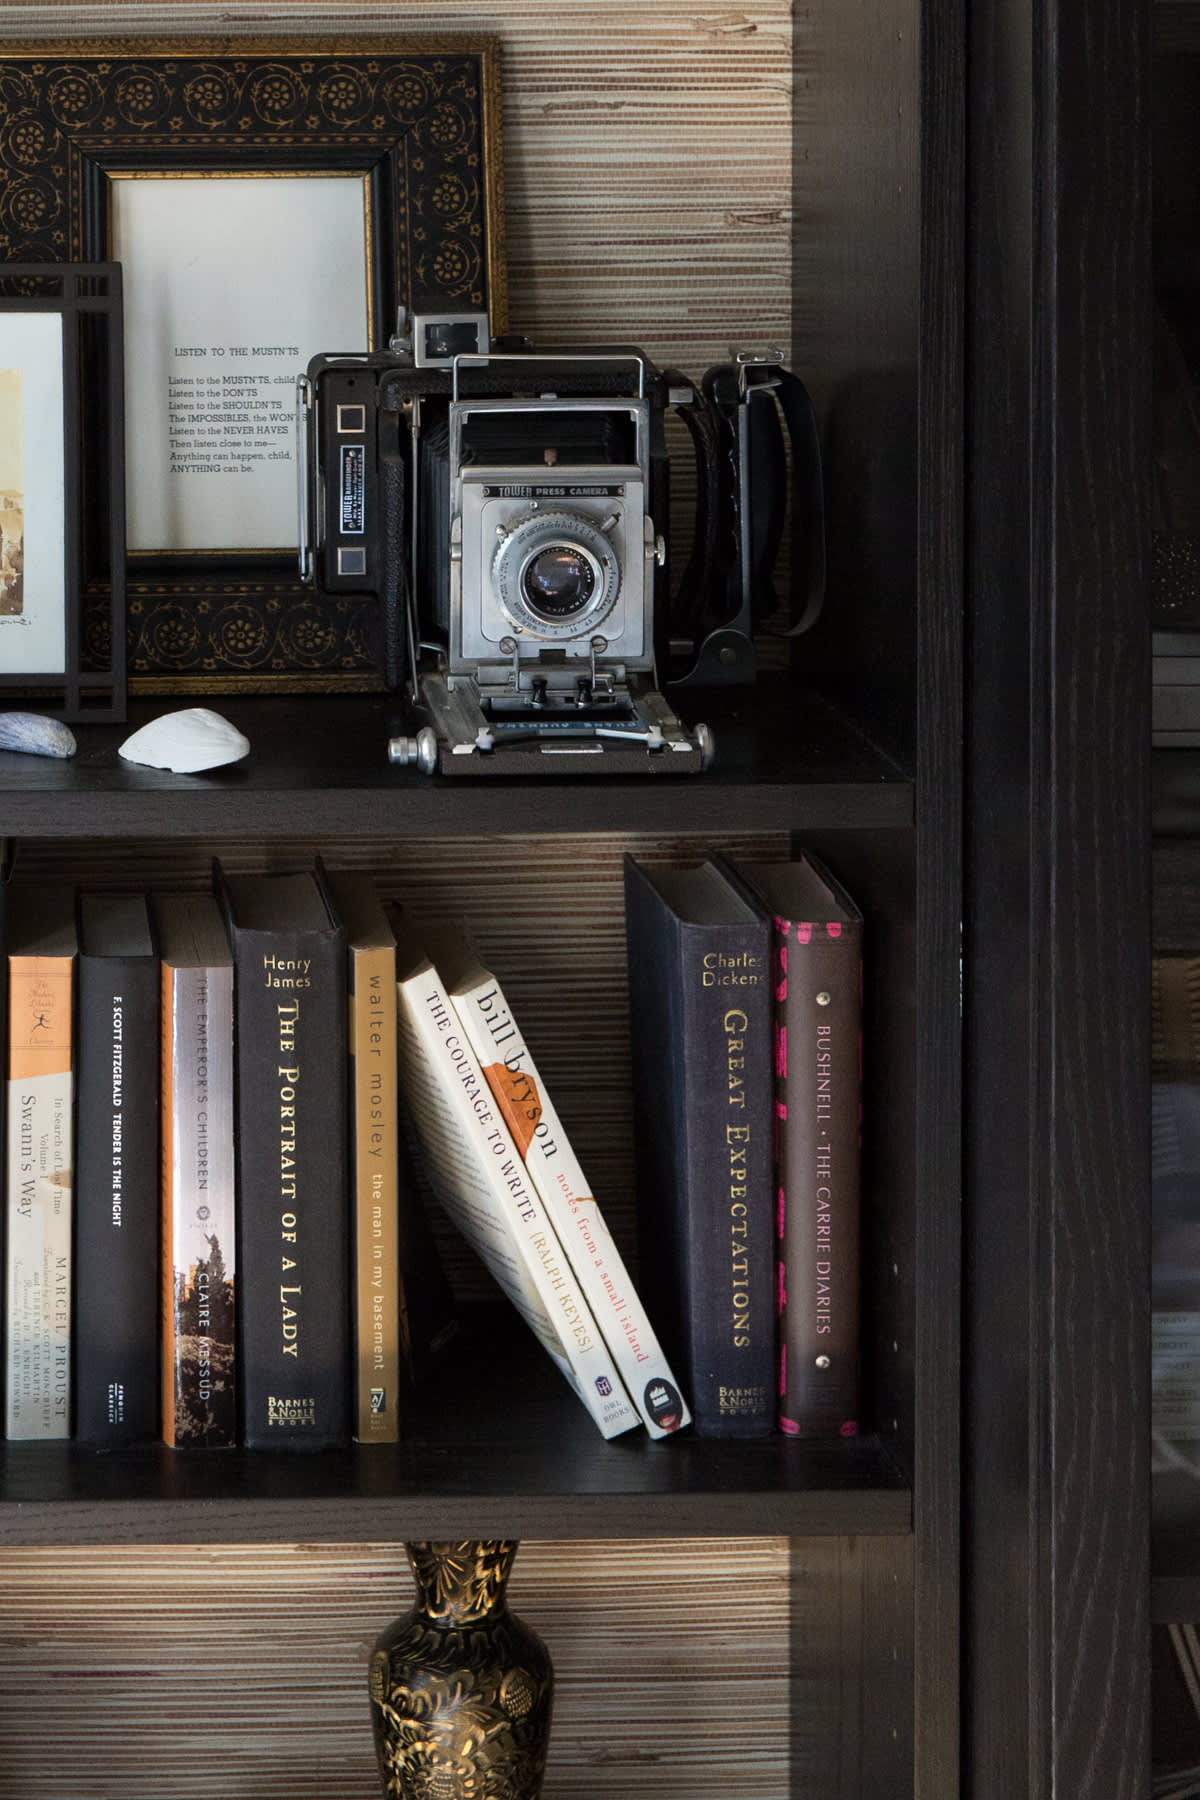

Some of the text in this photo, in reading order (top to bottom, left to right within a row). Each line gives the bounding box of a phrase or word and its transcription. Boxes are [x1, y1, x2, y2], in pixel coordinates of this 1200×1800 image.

[174, 347, 300, 356] LISTEN TO THE MUSTN'TS
[170, 464, 221, 473] ANYTHING
[223, 465, 239, 473] can
[500, 487, 608, 497] TOWER PRESS CAMERA
[264, 955, 311, 974] Henry
[264, 973, 311, 988] James
[112, 996, 122, 1227] F. SCOTT FITZGERALD TENDER IS THE NIGHT
[197, 977, 210, 1190] THE EMPEROR'S CHILDREN
[426, 990, 538, 1224] THE COURAGE TO WRITE
[476, 988, 558, 1161] bill bryson
[278, 1065, 300, 1200] PORTRAIT
[723, 1009, 751, 1347] GREAT EXPECTATIONS
[816, 1025, 832, 1335] BUSHNELL THE CARRIE DIARIES
[281, 1212, 297, 1243] OF
[282, 1256, 297, 1271] A
[198, 1273, 212, 1400] CLAIRE MESSUD
[280, 1285, 302, 1358] LADY
